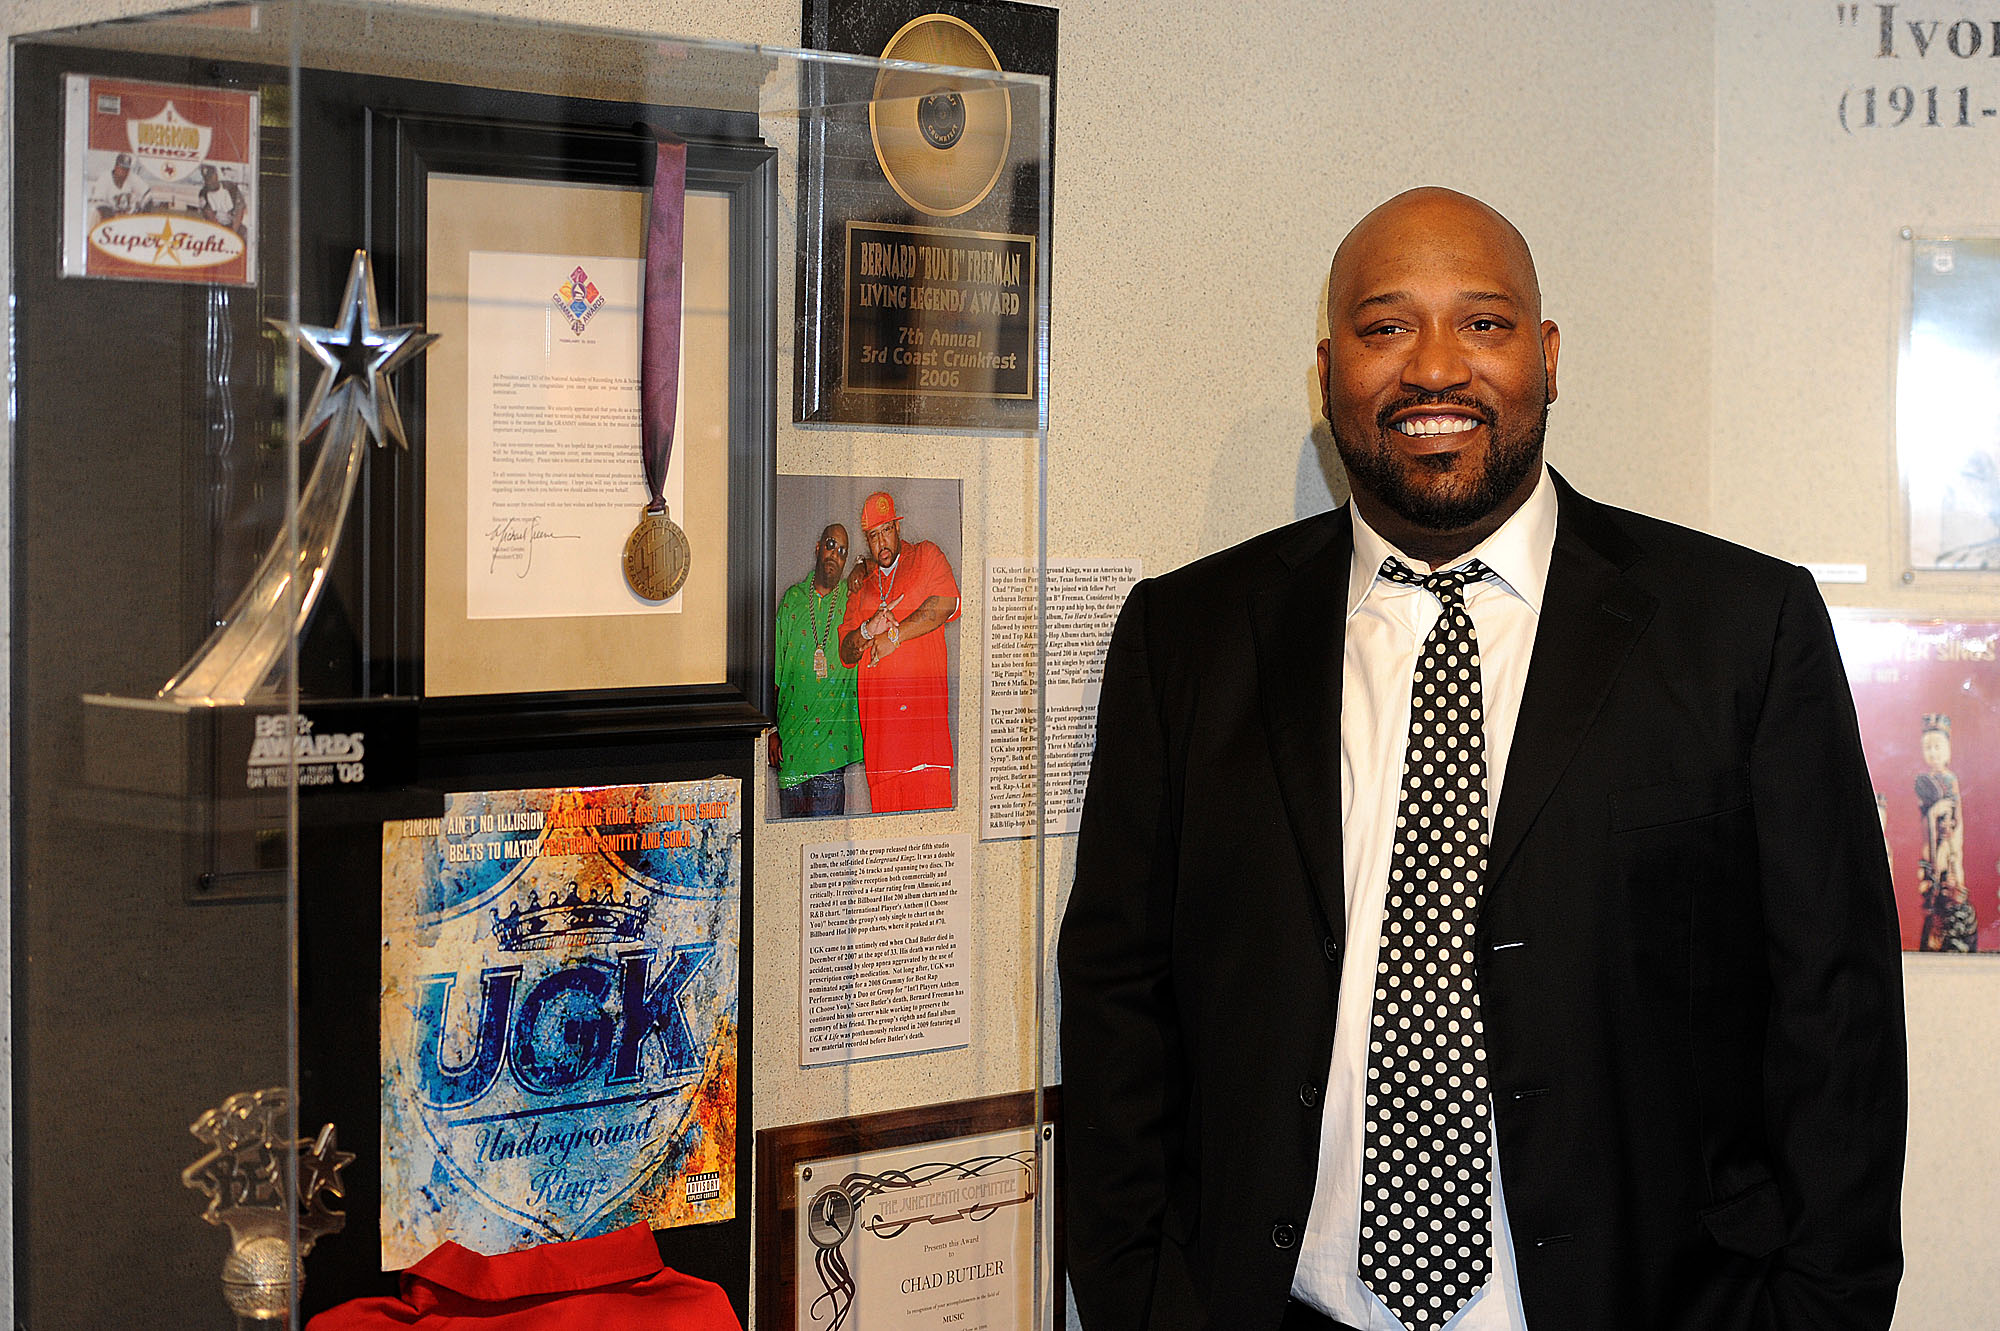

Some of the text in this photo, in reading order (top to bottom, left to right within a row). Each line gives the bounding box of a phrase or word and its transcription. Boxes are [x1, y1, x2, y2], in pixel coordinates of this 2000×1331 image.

[138, 147, 199, 158] KINGZ
[98, 226, 163, 252] Super
[860, 241, 1021, 288] BERNARD "BUN B" FREEMAN
[582, 295, 605, 325] AWARDS
[859, 283, 1020, 316] LIVING LEGENDS AWARD
[899, 326, 982, 348] 7th Annual
[861, 345, 1017, 370] 3rd Coast Crunkfest
[919, 369, 960, 388] 2006
[250, 732, 365, 762] AWARDS
[337, 762, 365, 783] '08
[447, 815, 477, 835] AIN'T
[479, 814, 494, 833] NO
[497, 811, 544, 832] ILLUSION
[547, 808, 602, 830] FEATURING
[605, 806, 631, 826] KOOL
[634, 805, 653, 824] ACE
[656, 804, 676, 824] AND
[678, 802, 697, 821] TOO
[698, 801, 730, 820] SHORT
[449, 830, 691, 863] BELTS TO MATCH FEATURING SMITTY AND SONJI
[821, 851, 838, 859] August
[829, 869, 857, 878] containing
[894, 864, 917, 873] spanning
[865, 857, 899, 866] Underground
[809, 891, 834, 900] critically.
[885, 885, 901, 893] rating
[842, 879, 862, 887] positive
[863, 877, 888, 886] reception
[901, 873, 935, 882] commercially
[410, 941, 717, 1113] UGK
[475, 1105, 659, 1168] Underground
[525, 1170, 613, 1214] Kingz
[687, 1180, 718, 1193] ADVISORY
[879, 1178, 1017, 1217] THE JUNETEENTH COMMITTEE
[924, 1235, 980, 1253] Presents this Award
[901, 1260, 1004, 1294] CHAD BUTLER
[942, 1312, 965, 1324] MUSIC
